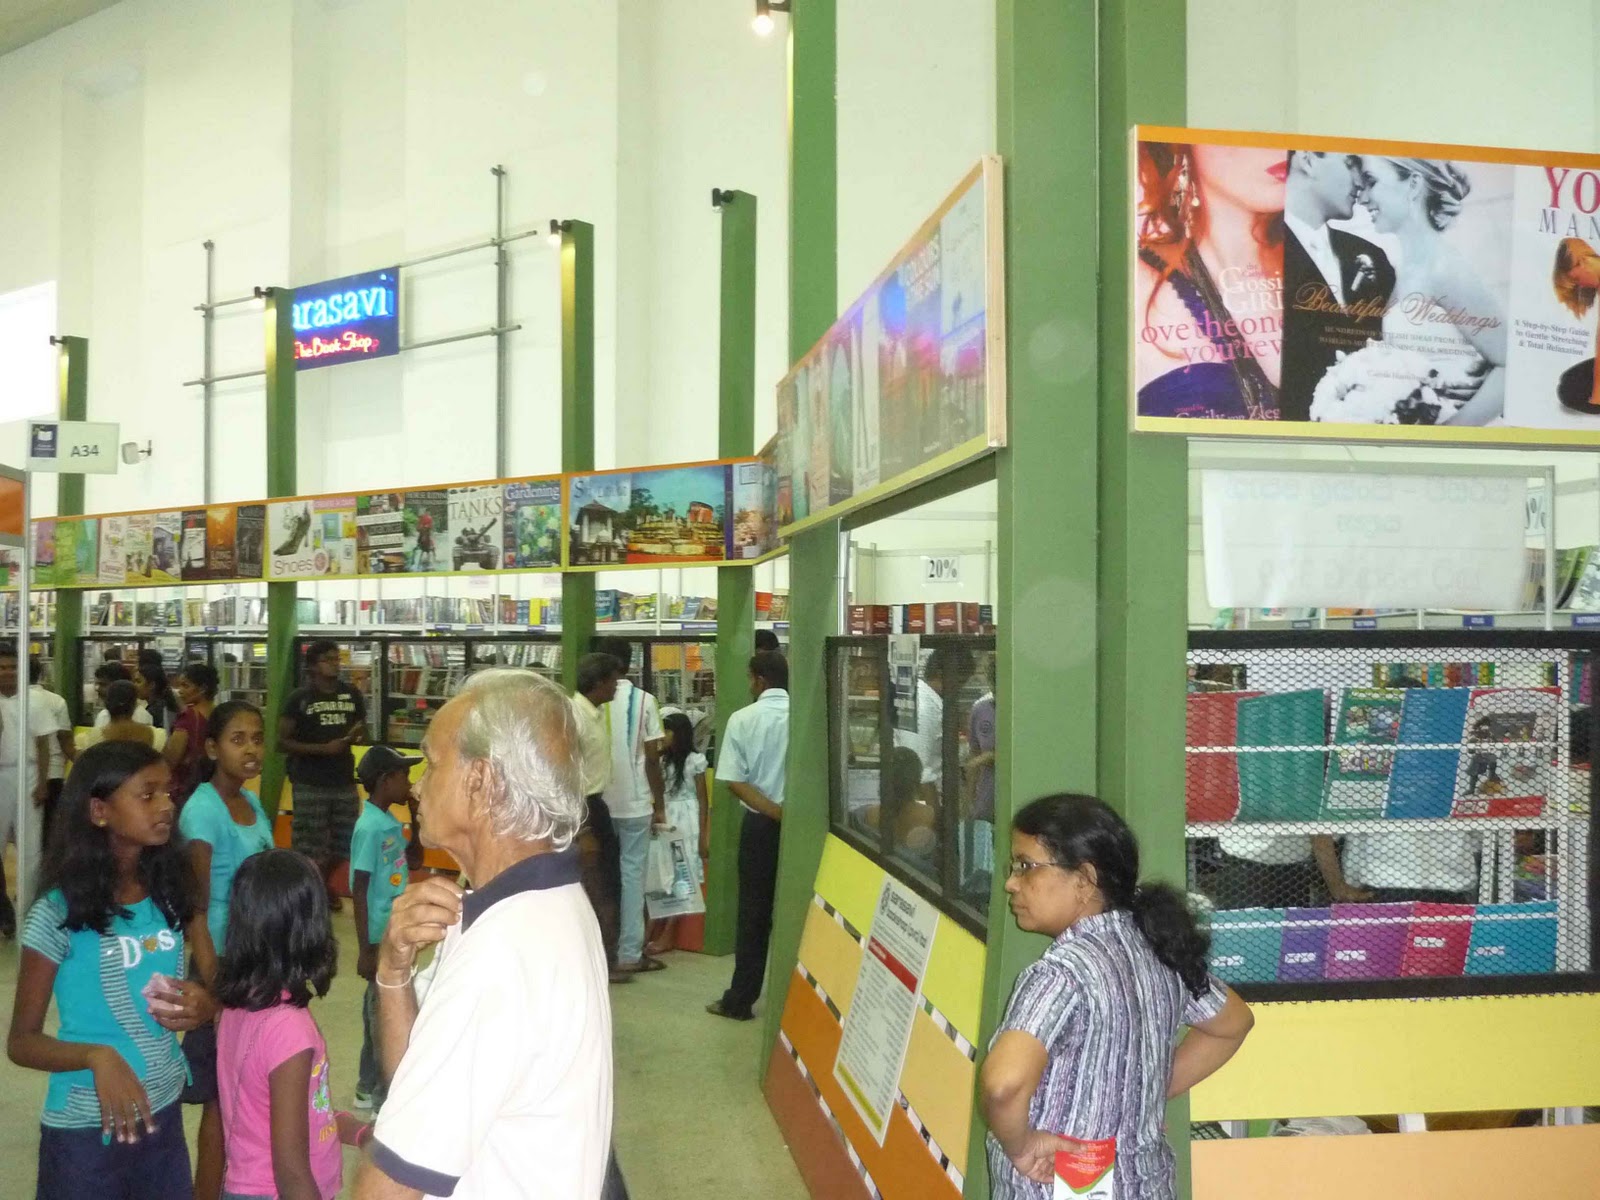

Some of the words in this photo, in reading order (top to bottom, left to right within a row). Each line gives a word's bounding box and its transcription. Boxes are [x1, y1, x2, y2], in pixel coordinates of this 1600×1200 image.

[1293, 281, 1398, 322] Beautiful
[1399, 292, 1502, 336] Weddings
[70, 444, 100, 457] A34
[505, 484, 561, 501] Gardening
[448, 496, 503, 519] TANKS
[274, 558, 313, 575] Shoes
[928, 558, 958, 579] 20%
